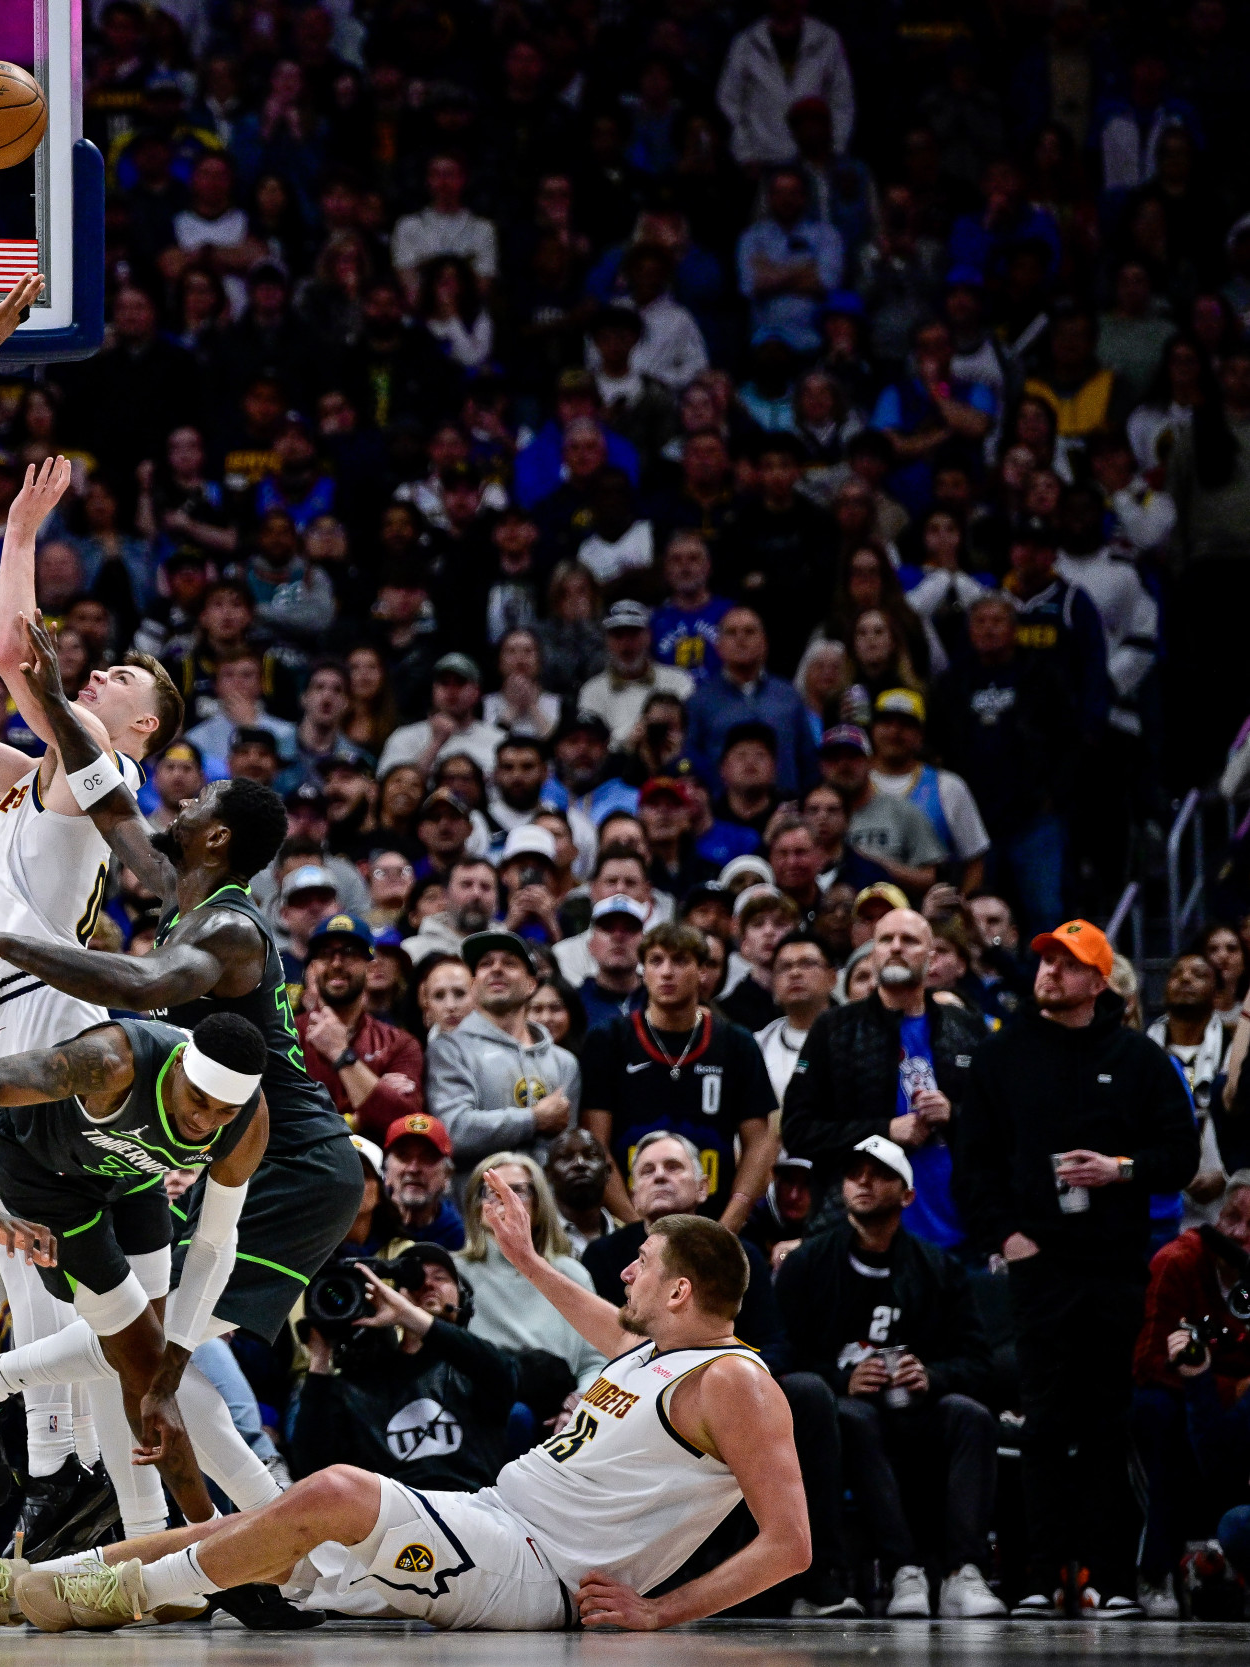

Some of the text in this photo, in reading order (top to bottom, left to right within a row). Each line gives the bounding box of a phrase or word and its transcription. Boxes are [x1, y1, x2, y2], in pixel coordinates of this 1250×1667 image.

[83, 773, 104, 792] 30
[701, 1074, 723, 1116] 0
[386, 1421, 456, 1453] TNT
[542, 1409, 599, 1464] 15
